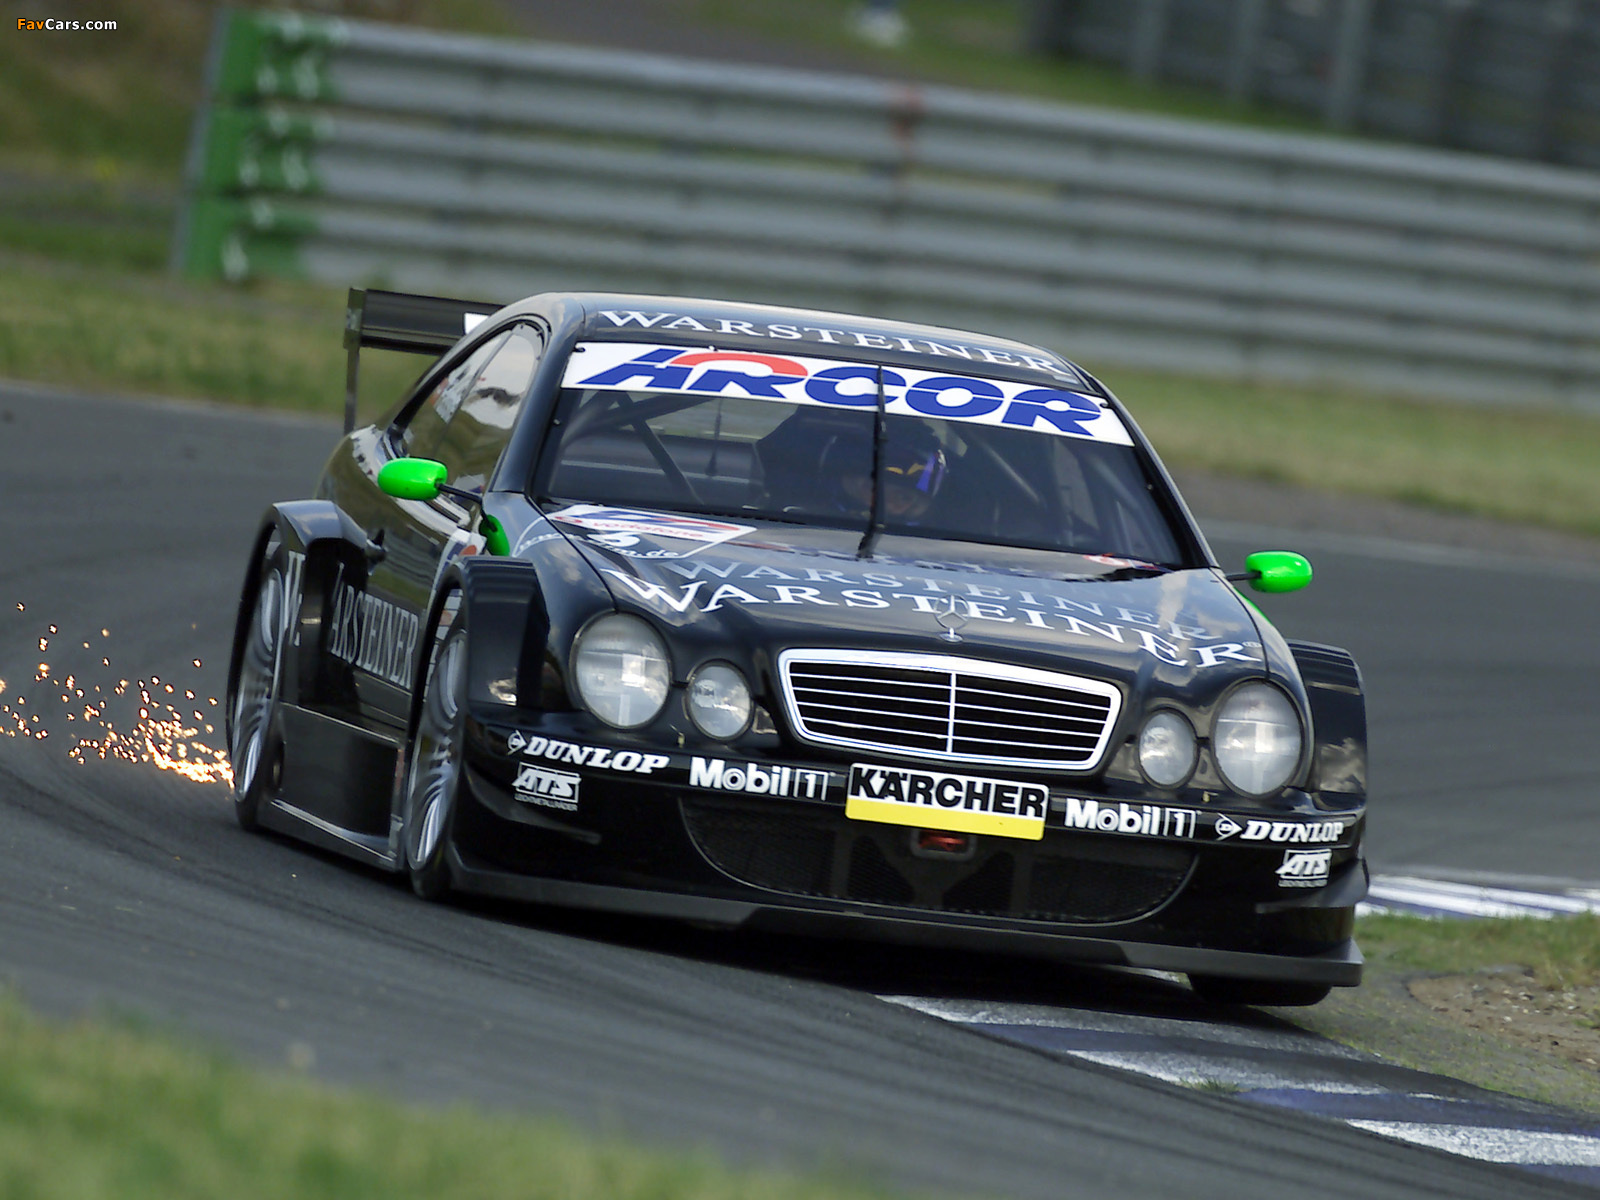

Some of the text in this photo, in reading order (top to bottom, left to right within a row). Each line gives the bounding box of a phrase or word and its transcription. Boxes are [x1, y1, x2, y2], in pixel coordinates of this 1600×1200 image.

[599, 310, 1072, 377] WARSTEINER
[575, 348, 1102, 437] ARCOR
[600, 568, 1262, 668] WARSTEINER
[658, 560, 1222, 641] WARSTEINER
[523, 735, 671, 774] DUNLOP
[512, 767, 582, 798] ATS
[689, 756, 791, 797] Mobil
[850, 766, 1047, 818] KÄRCHER
[1064, 798, 1161, 836] Mobil
[1239, 819, 1344, 843] DUNLOP
[1275, 852, 1332, 876] ATS
